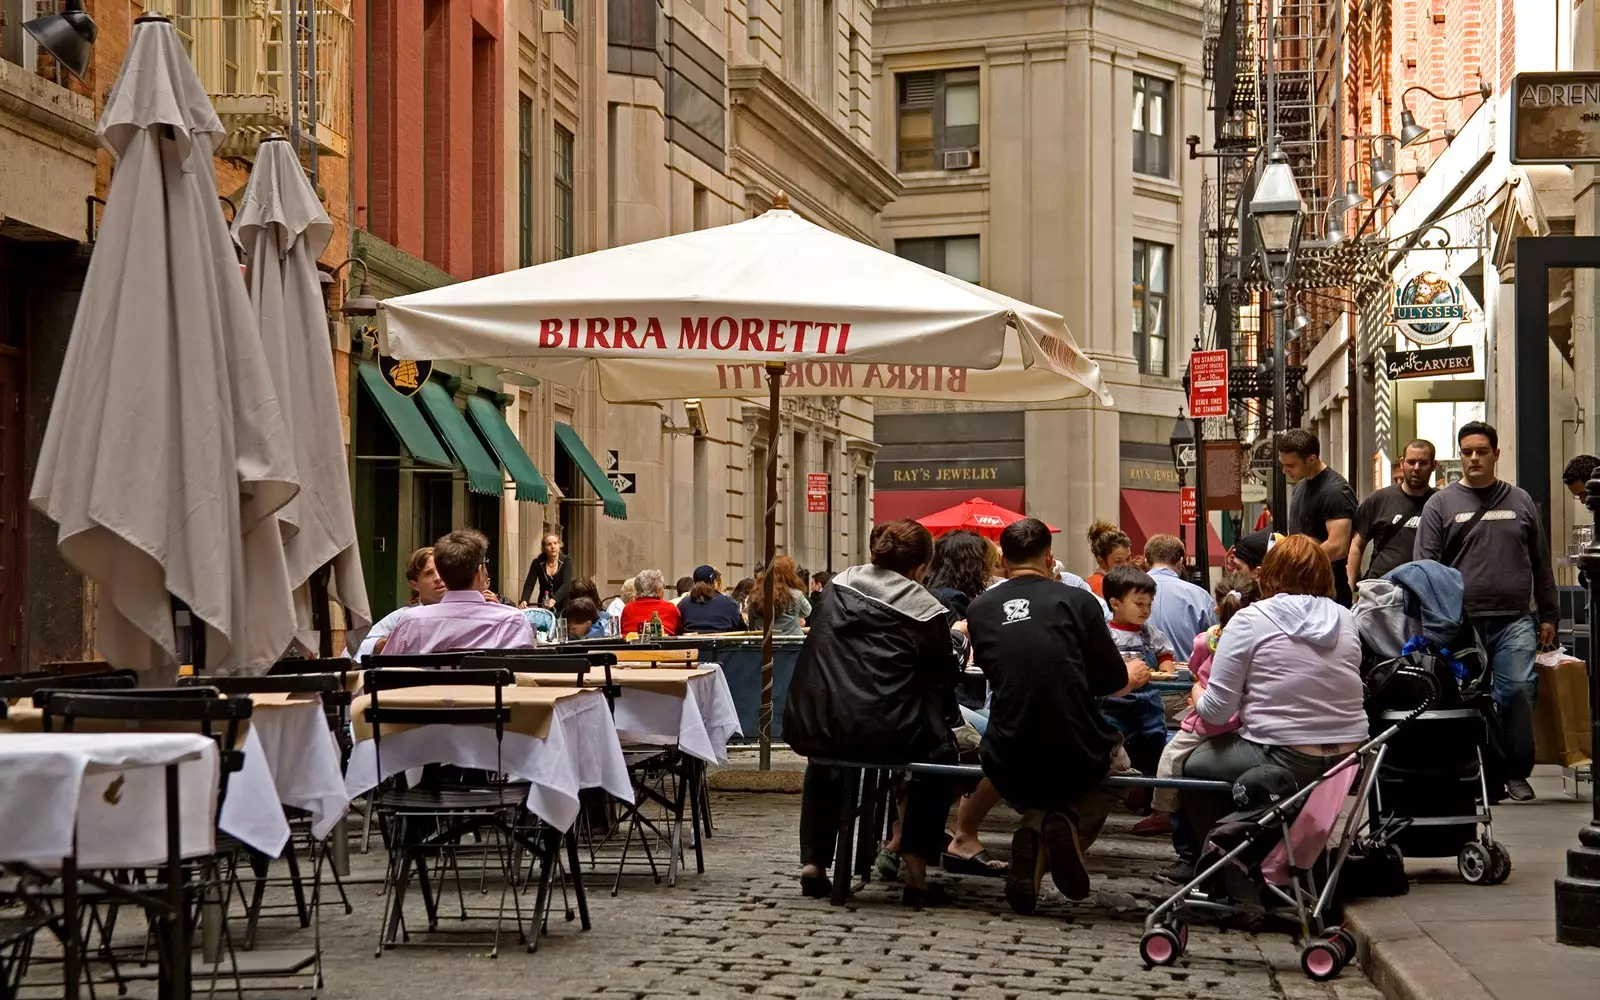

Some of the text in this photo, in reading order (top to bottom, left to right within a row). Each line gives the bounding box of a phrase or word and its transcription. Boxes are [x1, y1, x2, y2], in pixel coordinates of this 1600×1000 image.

[1520, 84, 1600, 107] ADRIEN
[537, 316, 852, 355] BIRRA MORETTI
[1389, 352, 1471, 378] Swift CARVERY
[1202, 405, 1223, 413] STANDING
[1182, 450, 1193, 461] ONE
[893, 467, 999, 481] RAY'S JEWELRY
[1154, 469, 1180, 482] JEWELR
[1189, 490, 1196, 499] N
